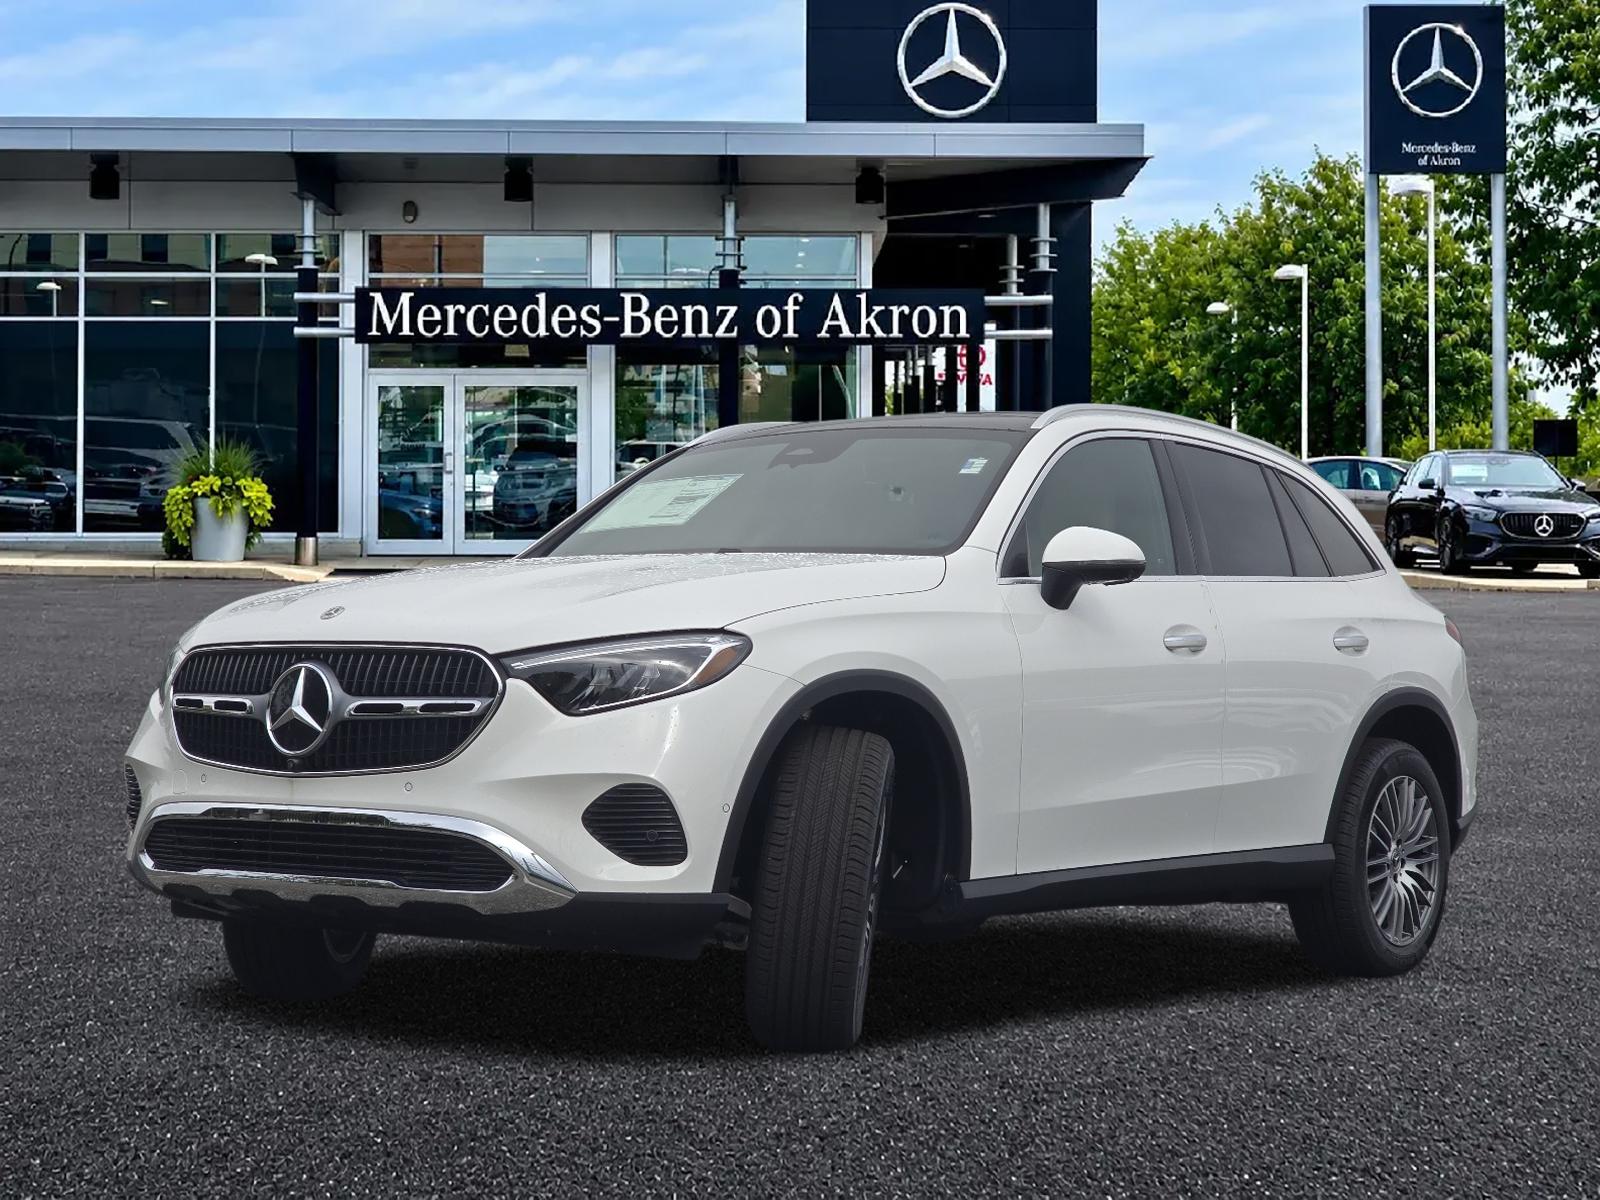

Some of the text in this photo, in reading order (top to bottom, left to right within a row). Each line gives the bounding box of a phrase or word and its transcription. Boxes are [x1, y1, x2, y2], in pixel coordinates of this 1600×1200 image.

[1401, 141, 1477, 154] Mercedes-Benz
[1417, 154, 1461, 166] of Akron
[367, 291, 971, 338] Mercedes-Benz of Akron
